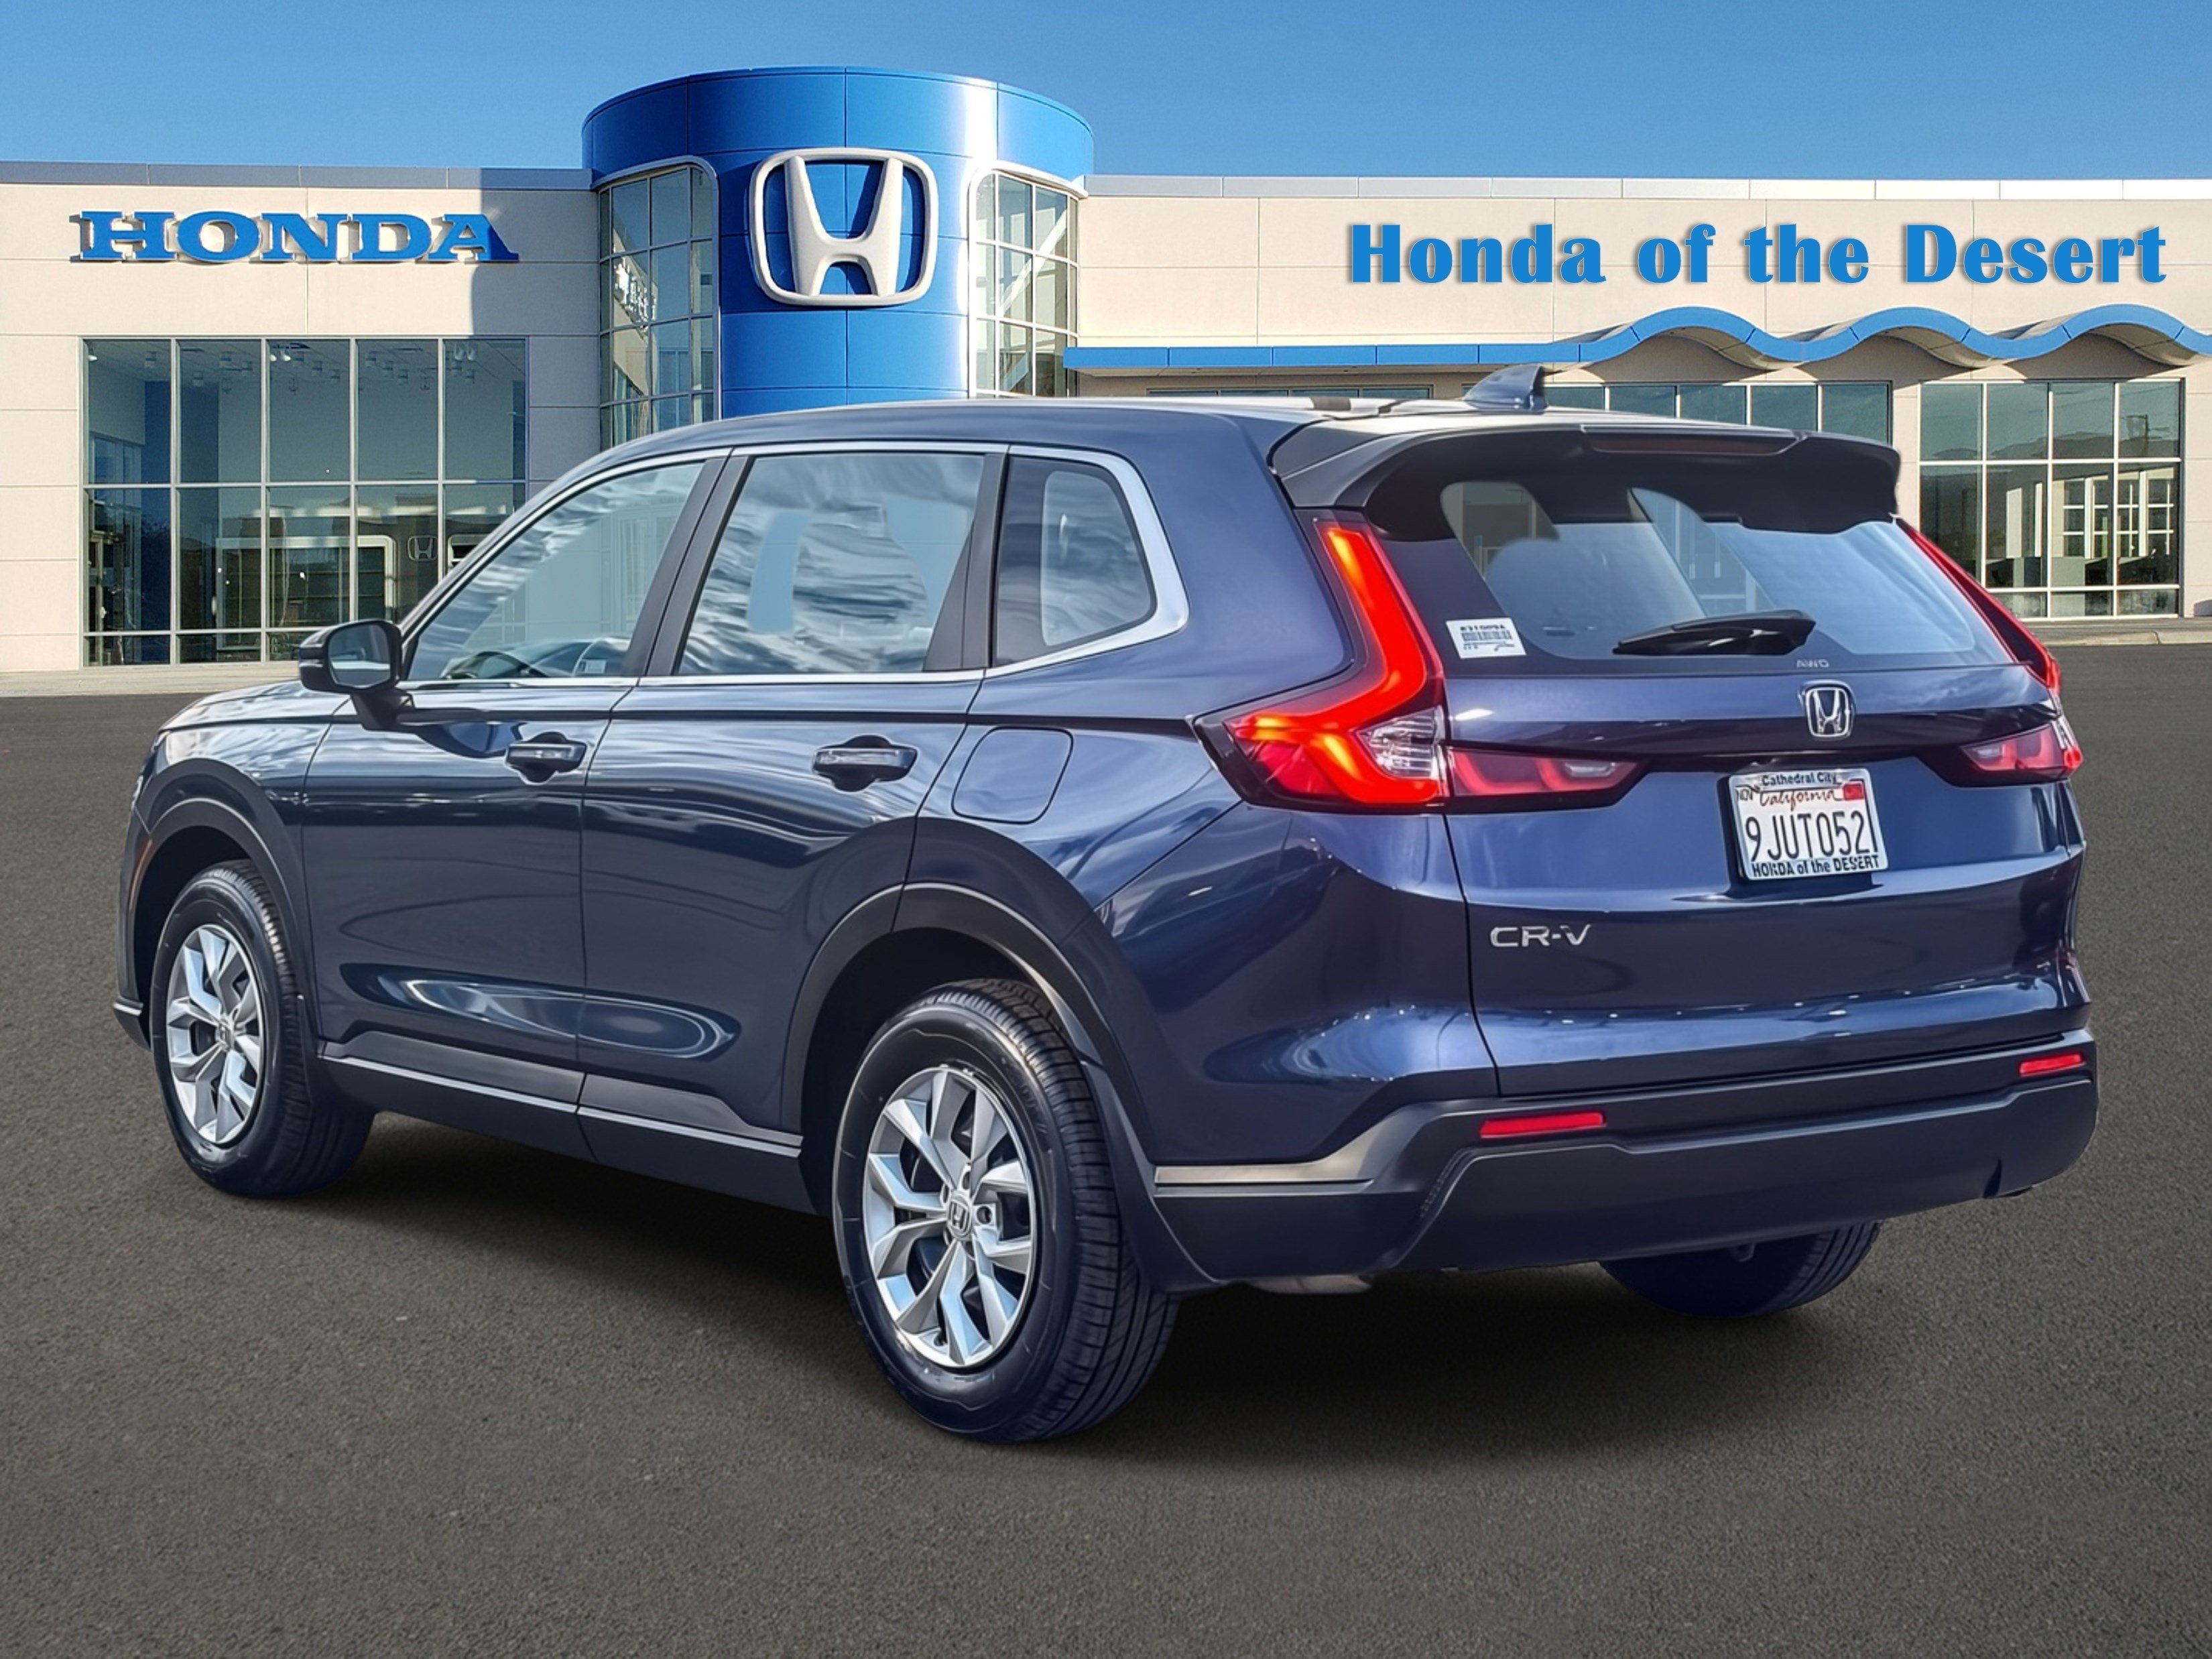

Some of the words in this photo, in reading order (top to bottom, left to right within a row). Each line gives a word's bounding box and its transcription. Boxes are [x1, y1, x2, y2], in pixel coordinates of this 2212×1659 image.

[74, 210, 519, 262] HONDA
[1351, 223, 1607, 284] Honda
[1638, 223, 1717, 284] of
[1743, 223, 1869, 284] the
[1906, 224, 2168, 284] Desert
[1762, 772, 1815, 786] Cathedral
[1817, 772, 1837, 784] City
[1760, 790, 1840, 811] California
[1745, 810, 1871, 862] 9JUT052
[1752, 861, 1794, 877] HONDA
[1797, 860, 1808, 874] of
[1811, 859, 1831, 873] the
[1833, 855, 1880, 871] DESERT
[1490, 924, 1592, 947] CR-V
